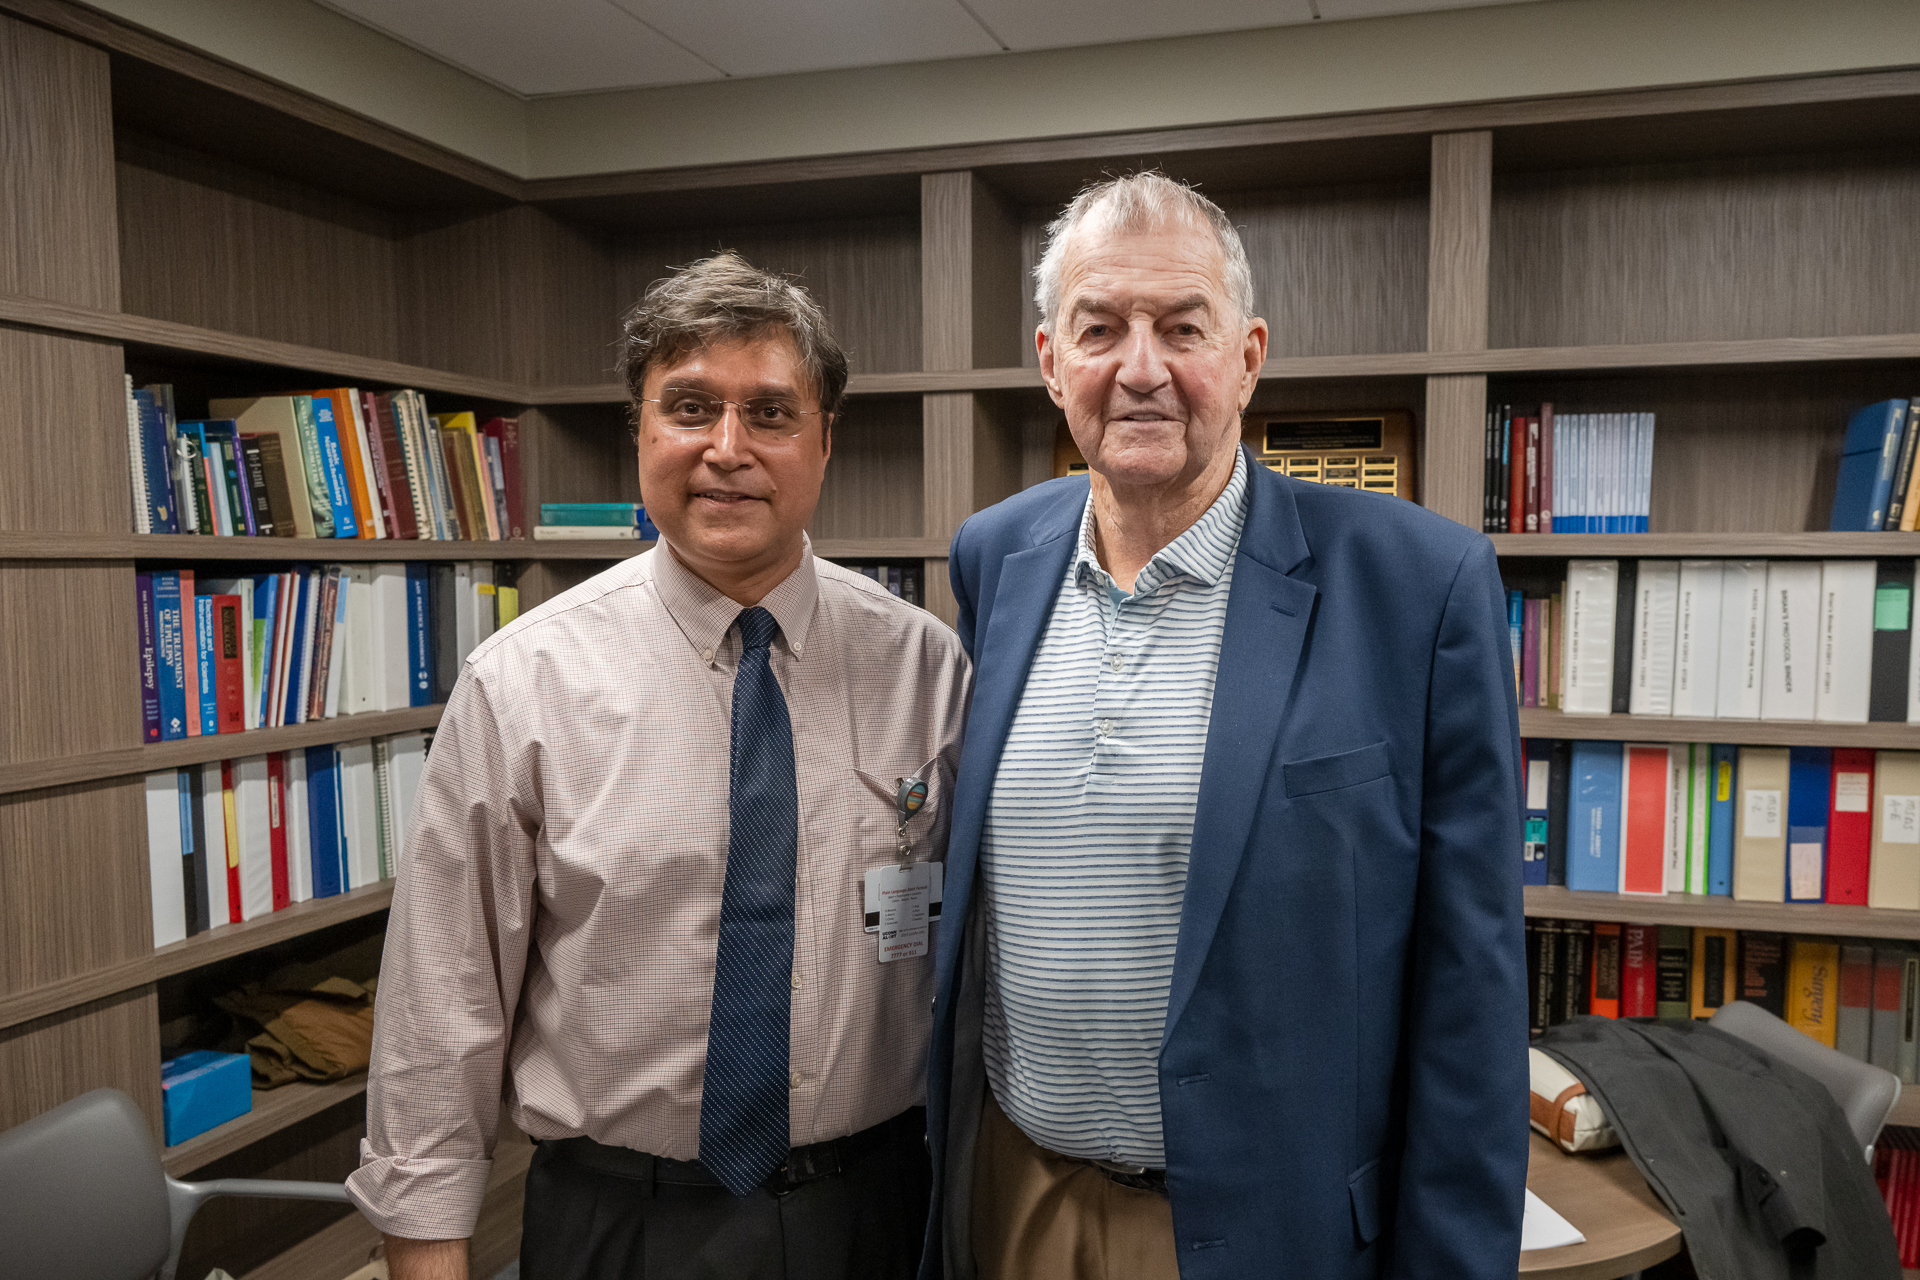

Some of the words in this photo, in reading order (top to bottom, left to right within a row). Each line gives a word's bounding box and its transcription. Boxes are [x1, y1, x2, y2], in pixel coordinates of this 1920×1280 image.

[324, 435, 343, 507] Neurochemistry
[330, 441, 340, 466] Basic
[163, 608, 172, 623] OF
[172, 608, 181, 629] THE
[198, 598, 208, 650] Instrumentation
[205, 598, 213, 637] Electronics
[1781, 589, 1789, 620] BRIAN'S
[164, 624, 174, 667] EPILEPSY
[173, 631, 183, 689] TREATMENT
[1782, 621, 1792, 663] PROTOCOL
[143, 647, 155, 690] Epilepsy
[200, 661, 210, 694] Scientists
[884, 943, 913, 952] EMERGENCY
[1626, 928, 1645, 969] PAIN
[1802, 962, 1829, 1025] Surgery
